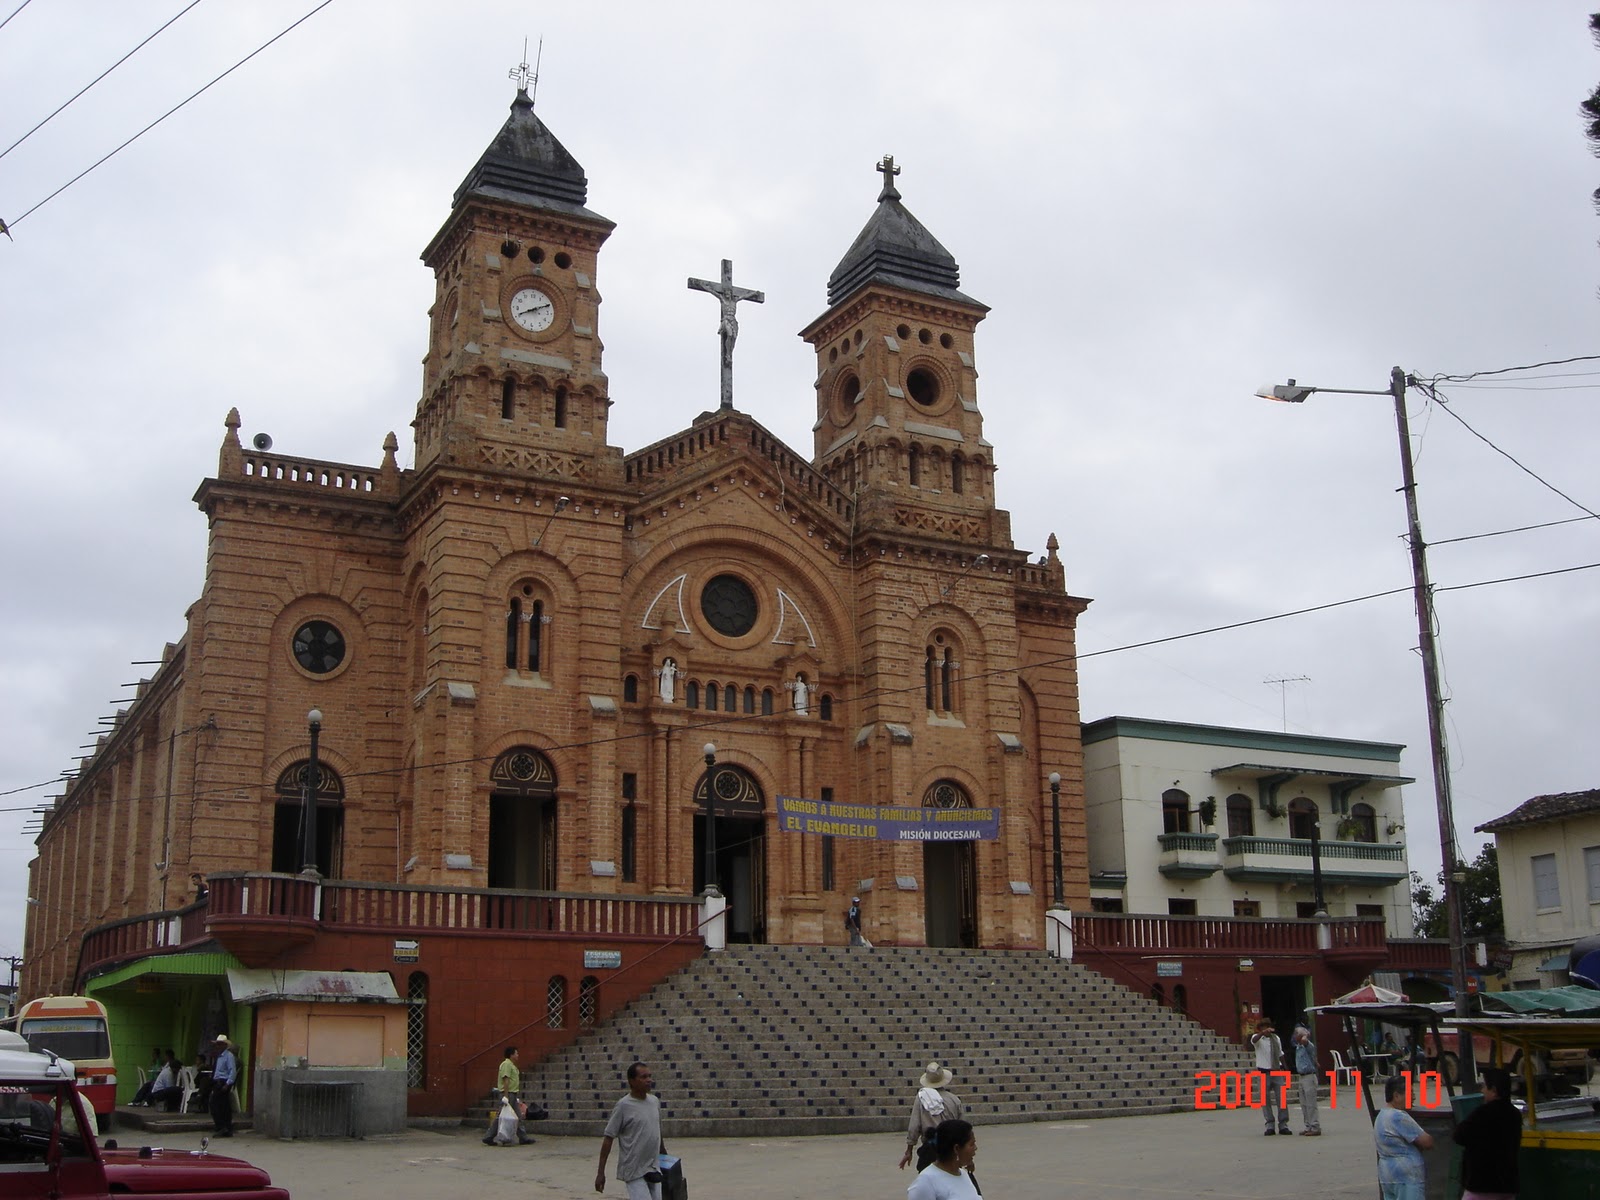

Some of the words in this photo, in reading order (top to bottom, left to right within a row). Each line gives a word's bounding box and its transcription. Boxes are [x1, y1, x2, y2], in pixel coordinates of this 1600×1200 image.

[783, 799, 817, 813] VAMOS
[821, 805, 827, 815] A
[830, 805, 877, 820] NUESTRAS
[879, 808, 922, 821] FAMILIAS
[926, 811, 932, 821] Y
[935, 810, 993, 821] ANUNCIEMOS
[787, 817, 802, 830] EL
[807, 820, 877, 837] EVANGELIO
[900, 829, 931, 840] MISIÓN
[933, 830, 981, 840] DIOCESANA
